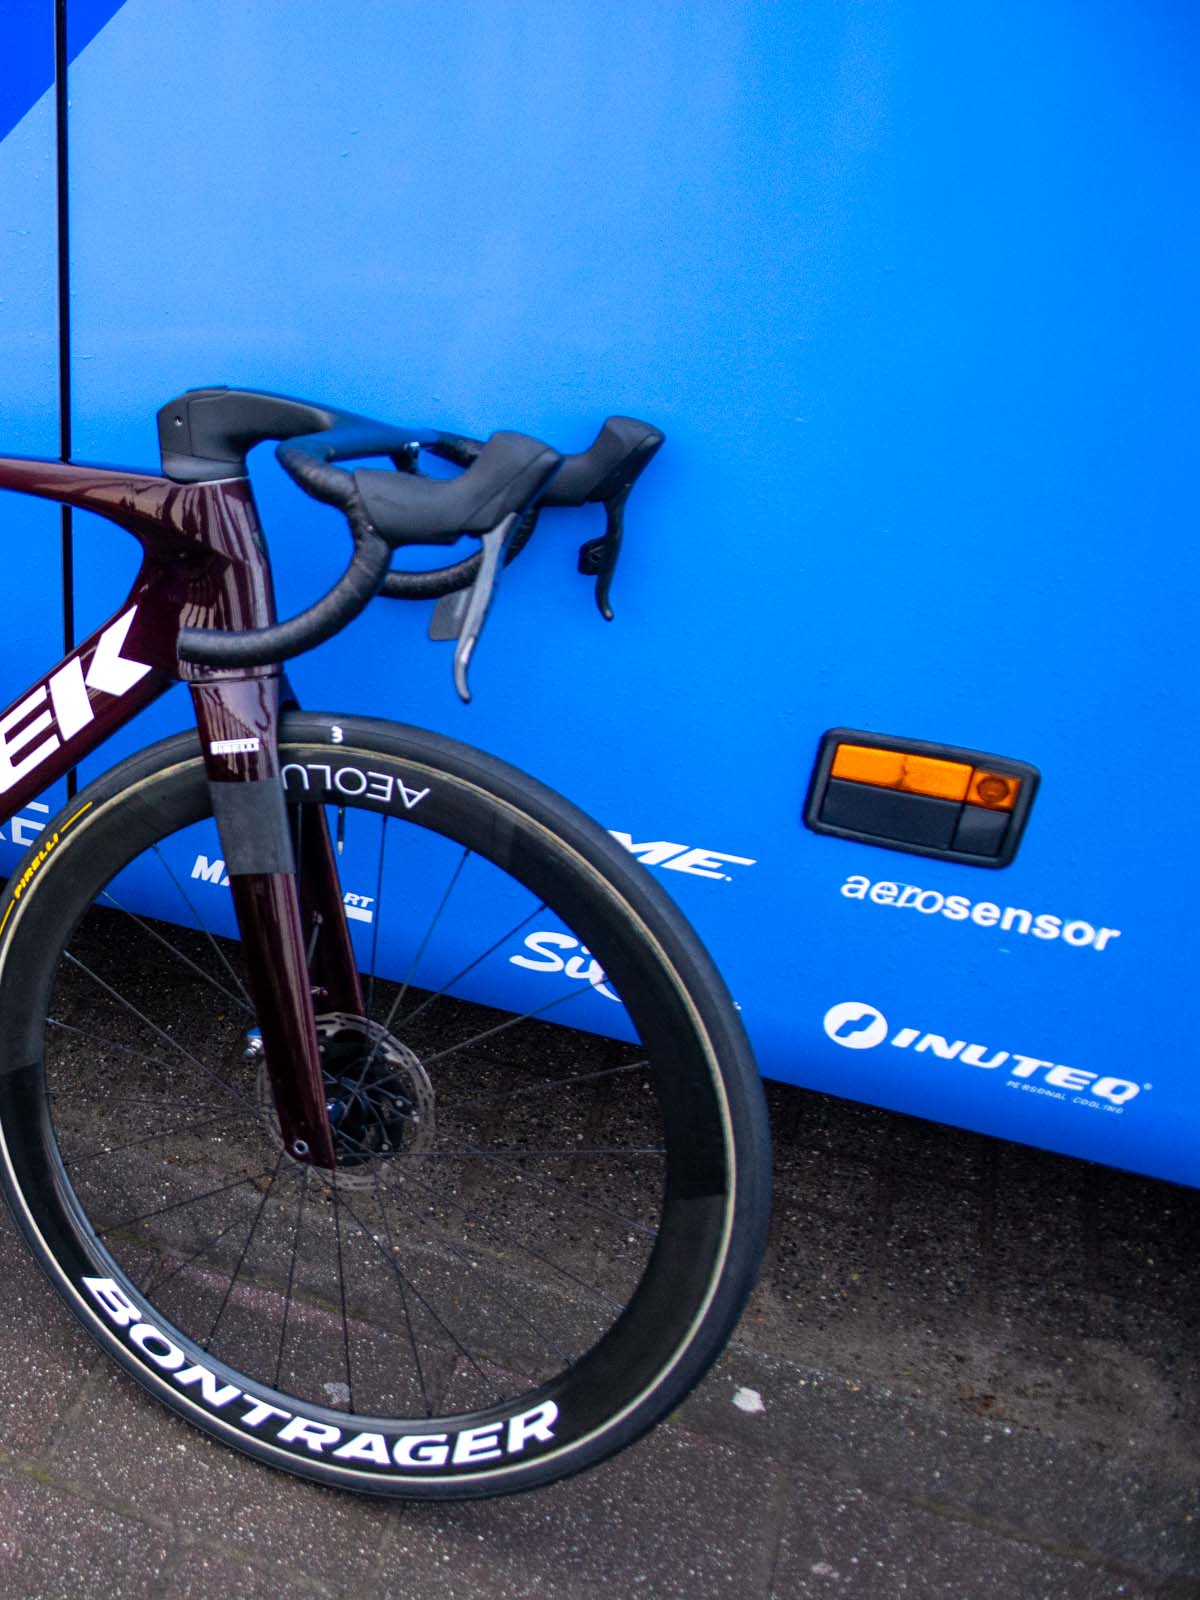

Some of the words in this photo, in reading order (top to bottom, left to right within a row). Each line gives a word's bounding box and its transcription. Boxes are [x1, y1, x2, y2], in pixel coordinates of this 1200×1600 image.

[280, 764, 430, 809] AEOLU
[14, 832, 60, 900] PIRELLI
[840, 874, 1122, 951] aerosensor
[891, 1028, 1141, 1106] INUTEQ
[81, 1276, 559, 1467] BONTRAGER
